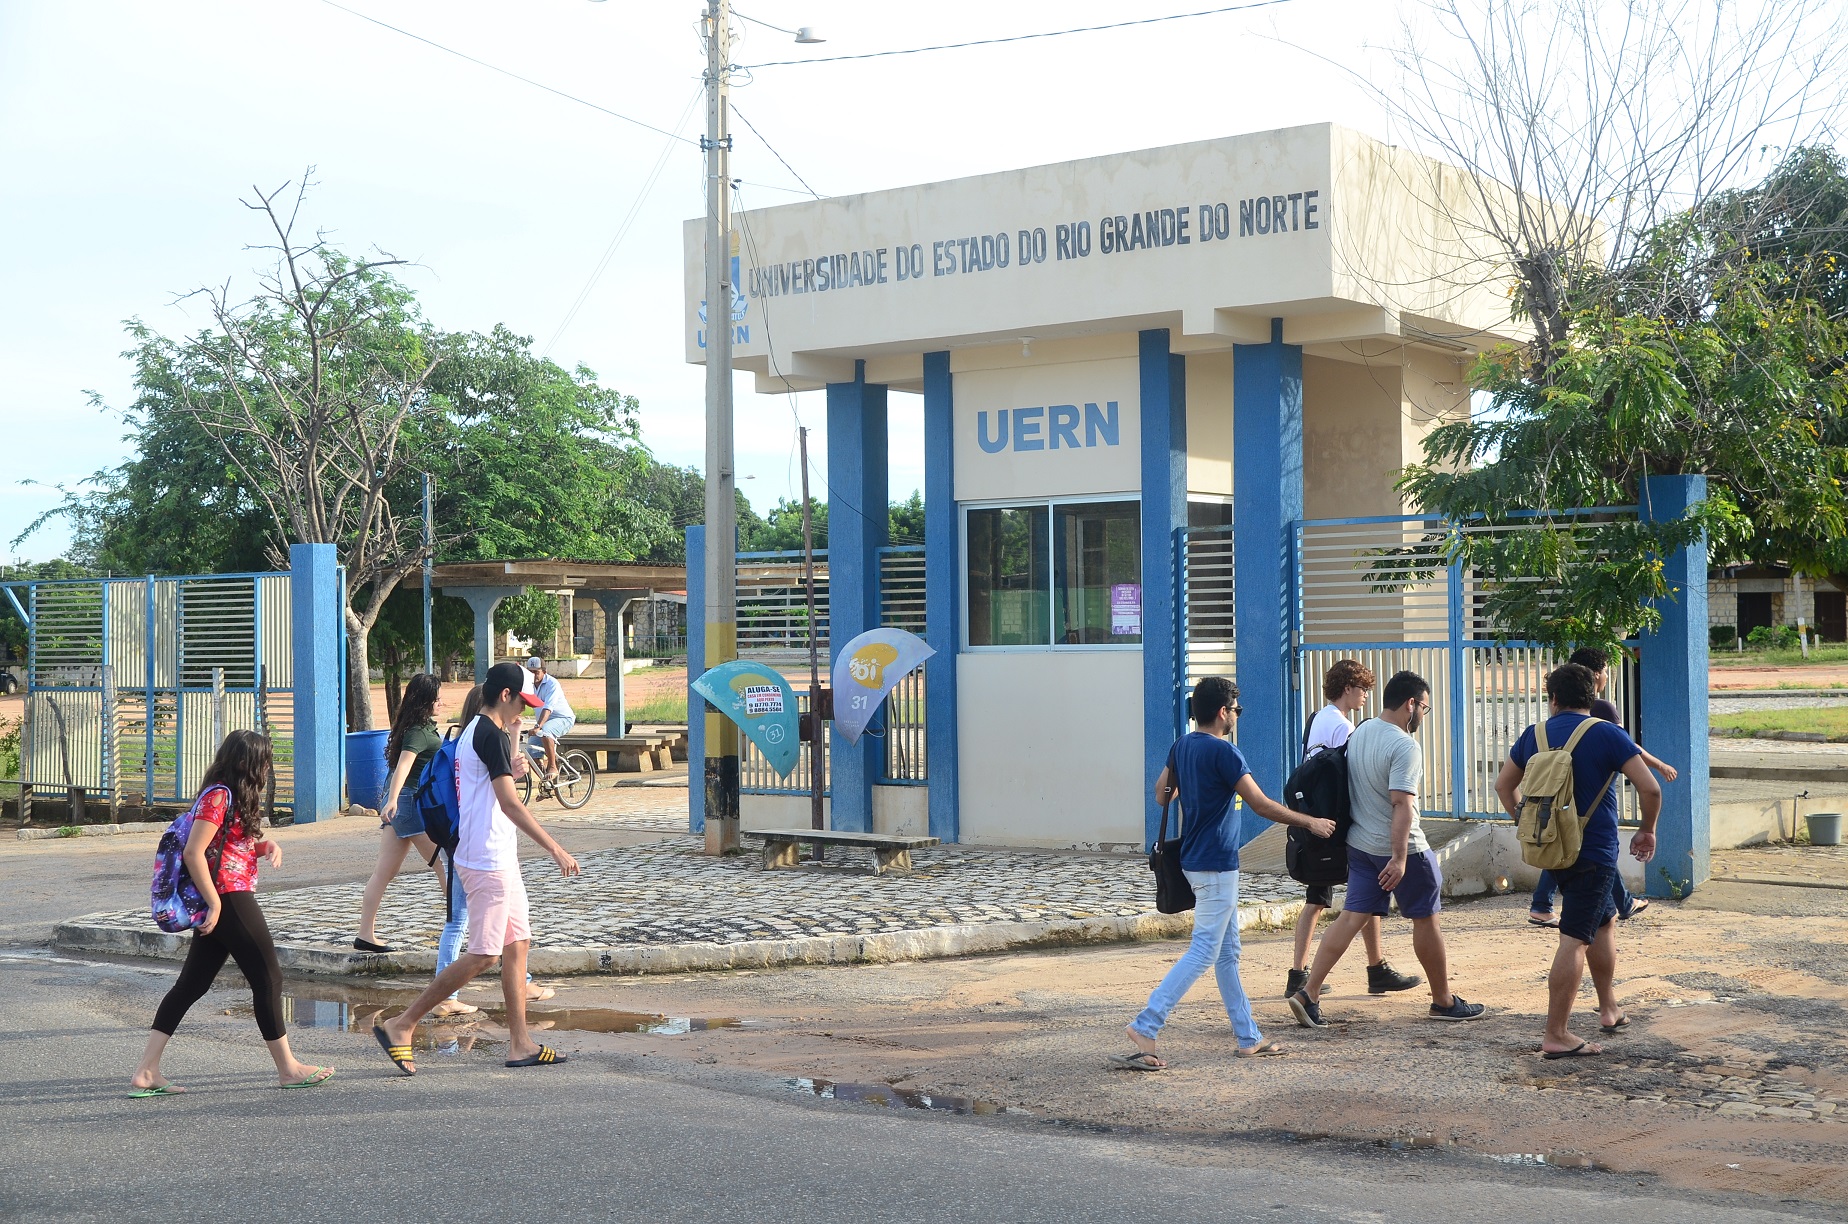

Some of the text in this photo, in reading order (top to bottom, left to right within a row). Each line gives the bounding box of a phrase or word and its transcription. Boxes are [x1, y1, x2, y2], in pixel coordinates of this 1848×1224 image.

[749, 190, 1319, 298] UNIVERSIDADE DO ESTADO DO RIO GRANDE DO NORTE
[697, 325, 750, 348] UN
[977, 401, 1120, 454] UERN
[747, 686, 781, 694] ALUGA-SE
[851, 695, 868, 710] 31
[769, 728, 782, 740] 31
